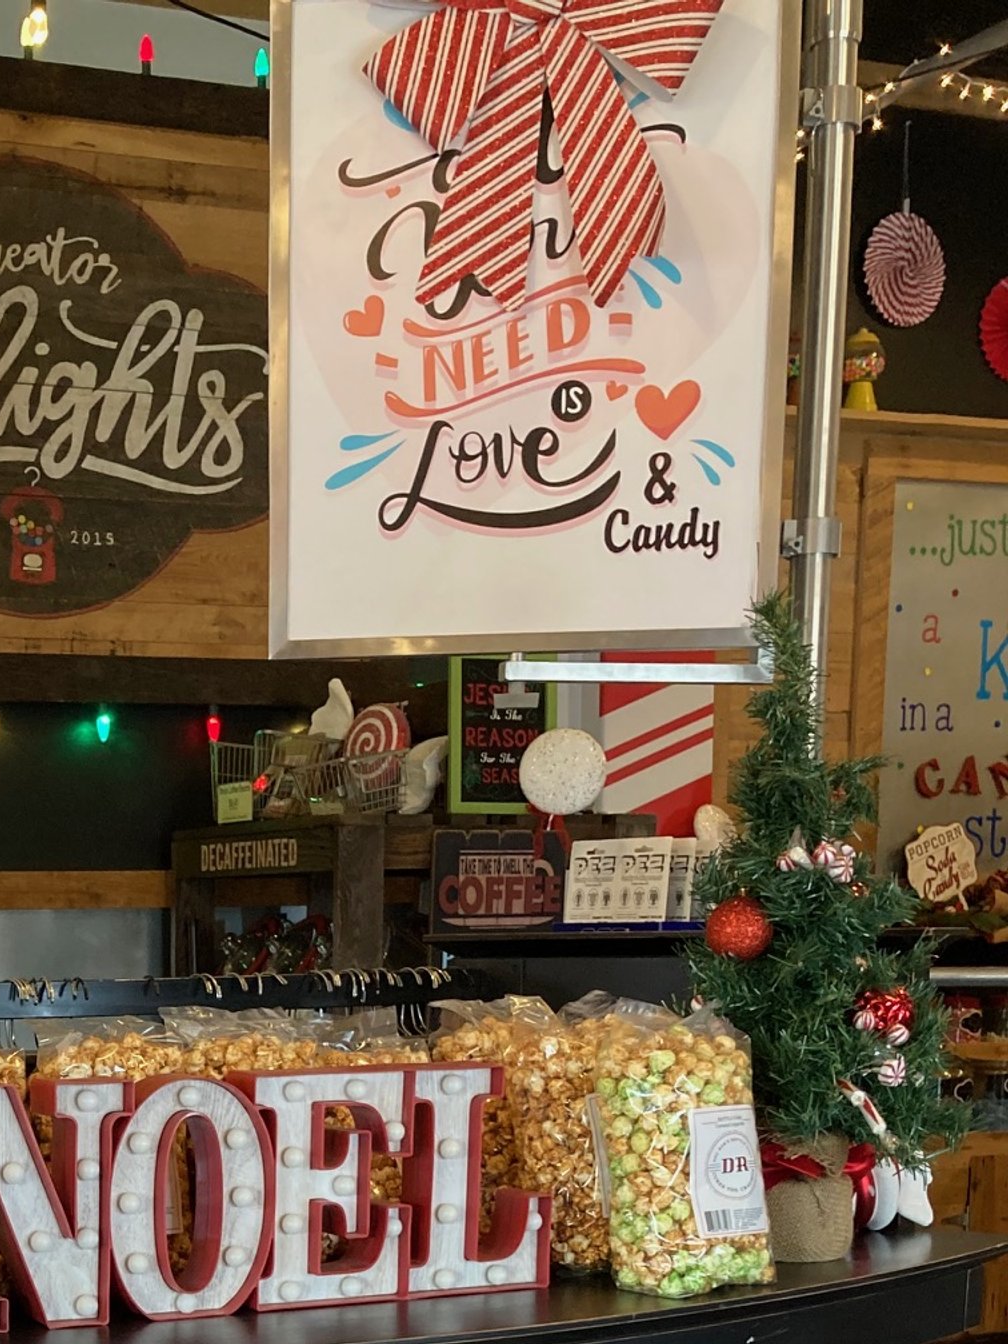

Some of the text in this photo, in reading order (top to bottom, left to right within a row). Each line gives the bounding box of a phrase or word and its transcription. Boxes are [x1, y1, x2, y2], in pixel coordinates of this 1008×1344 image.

[423, 297, 591, 402] NEED
[559, 387, 583, 415] IS
[379, 420, 621, 532] Love
[644, 452, 677, 506] &
[604, 508, 721, 560] Candy
[922, 614, 941, 644] a
[900, 697, 954, 732] in a
[482, 767, 519, 784] SEAS
[201, 839, 297, 872] DECAFFEINATED
[908, 825, 963, 860] POPCORN
[574, 856, 616, 875] PEZ
[621, 854, 665, 873] PEZ
[926, 846, 957, 880] Soda
[438, 875, 561, 914] COFFEE
[923, 866, 960, 900] Candy
[722, 1156, 749, 1174] DR
